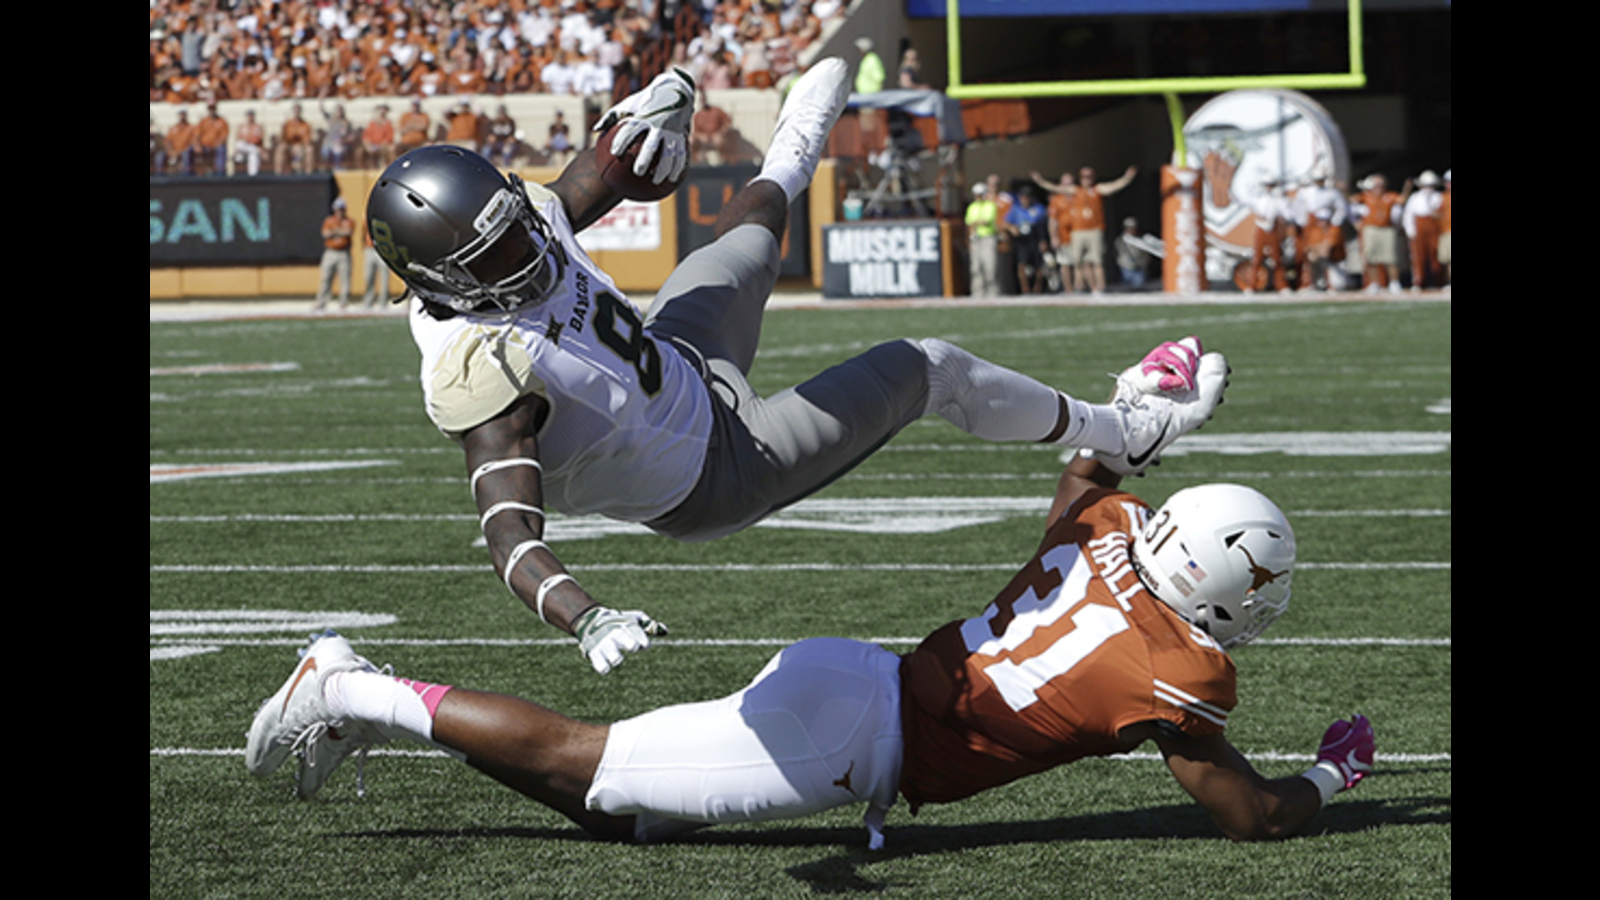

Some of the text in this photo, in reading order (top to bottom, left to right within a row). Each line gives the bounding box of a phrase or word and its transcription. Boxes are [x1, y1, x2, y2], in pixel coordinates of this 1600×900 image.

[828, 226, 940, 263] MUSCLE
[569, 271, 589, 333] BAYLOR
[849, 260, 921, 295] MILK
[1145, 510, 1179, 556] 31
[1087, 531, 1145, 613] HALL
[960, 543, 1129, 713] 31
